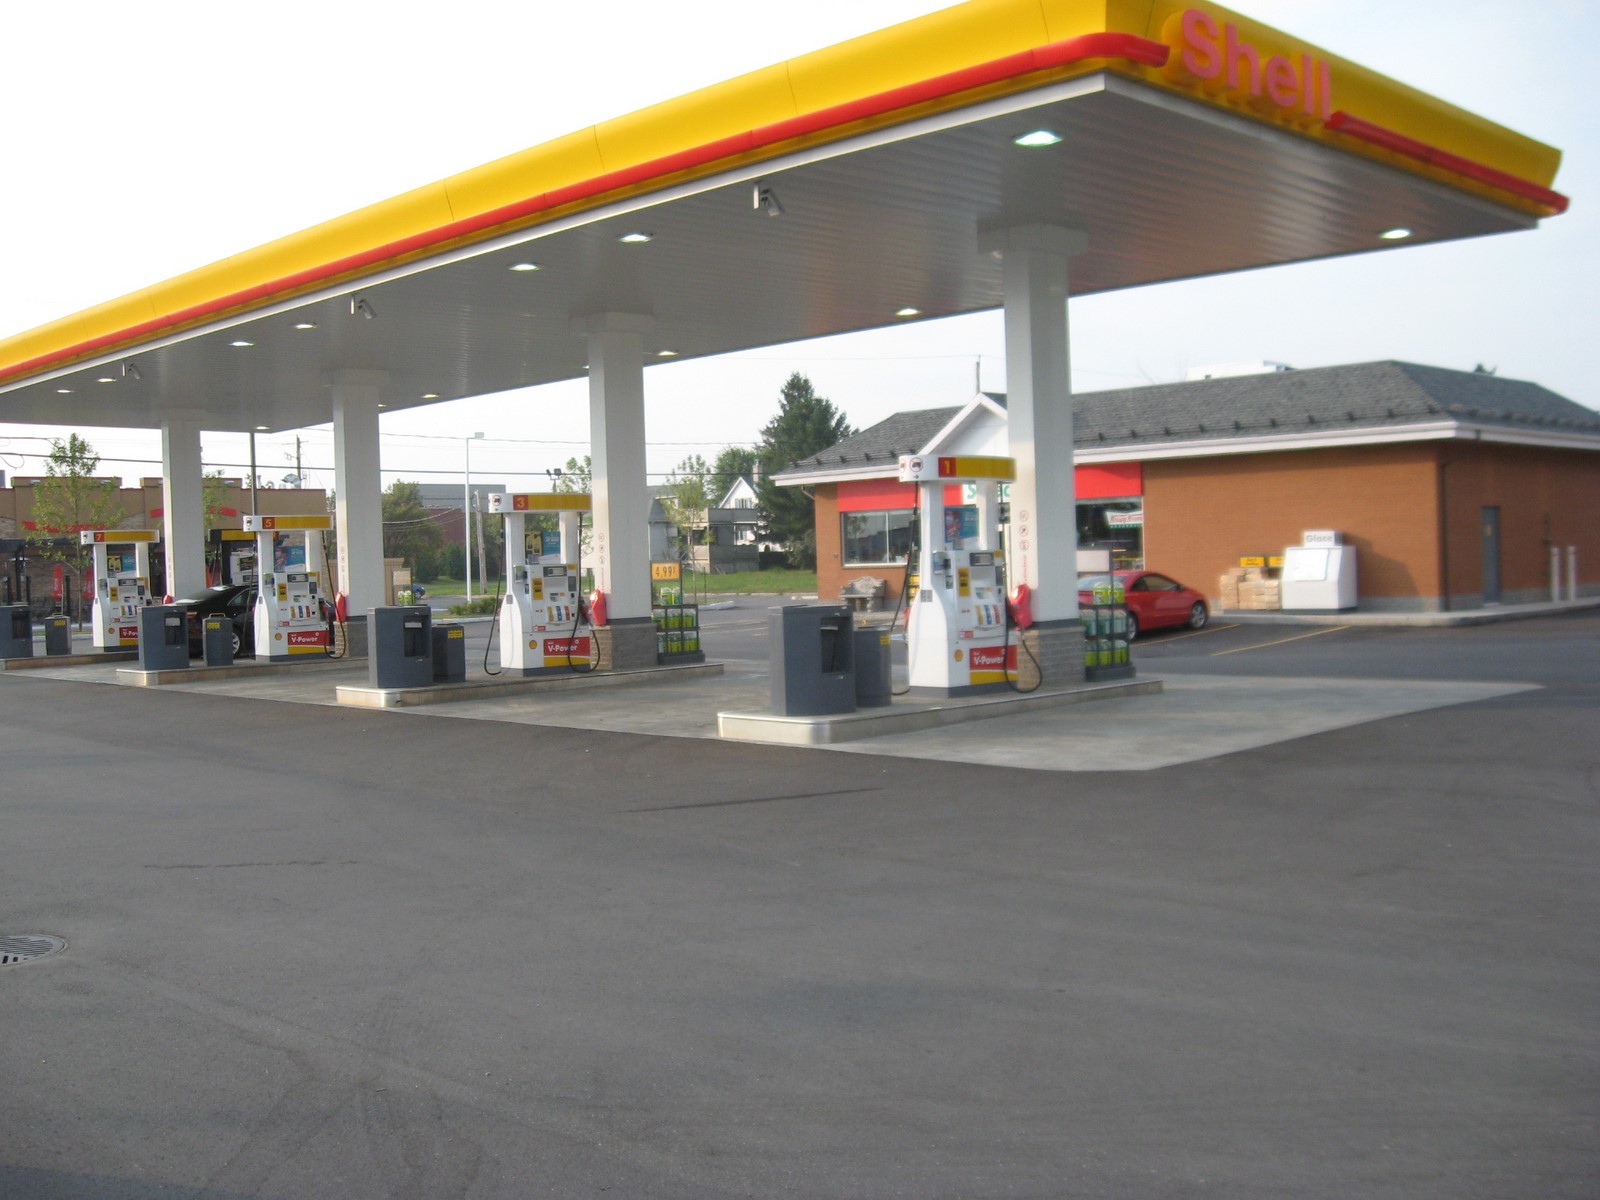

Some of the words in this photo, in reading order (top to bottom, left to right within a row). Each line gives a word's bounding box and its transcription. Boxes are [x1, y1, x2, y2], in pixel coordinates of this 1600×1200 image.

[1182, 9, 1331, 121] Shell
[944, 460, 951, 474] 1
[517, 497, 525, 508] 3
[265, 518, 272, 528] 5
[96, 533, 102, 541] 7
[1305, 534, 1333, 543] Glace
[973, 655, 1005, 666] V-Power
